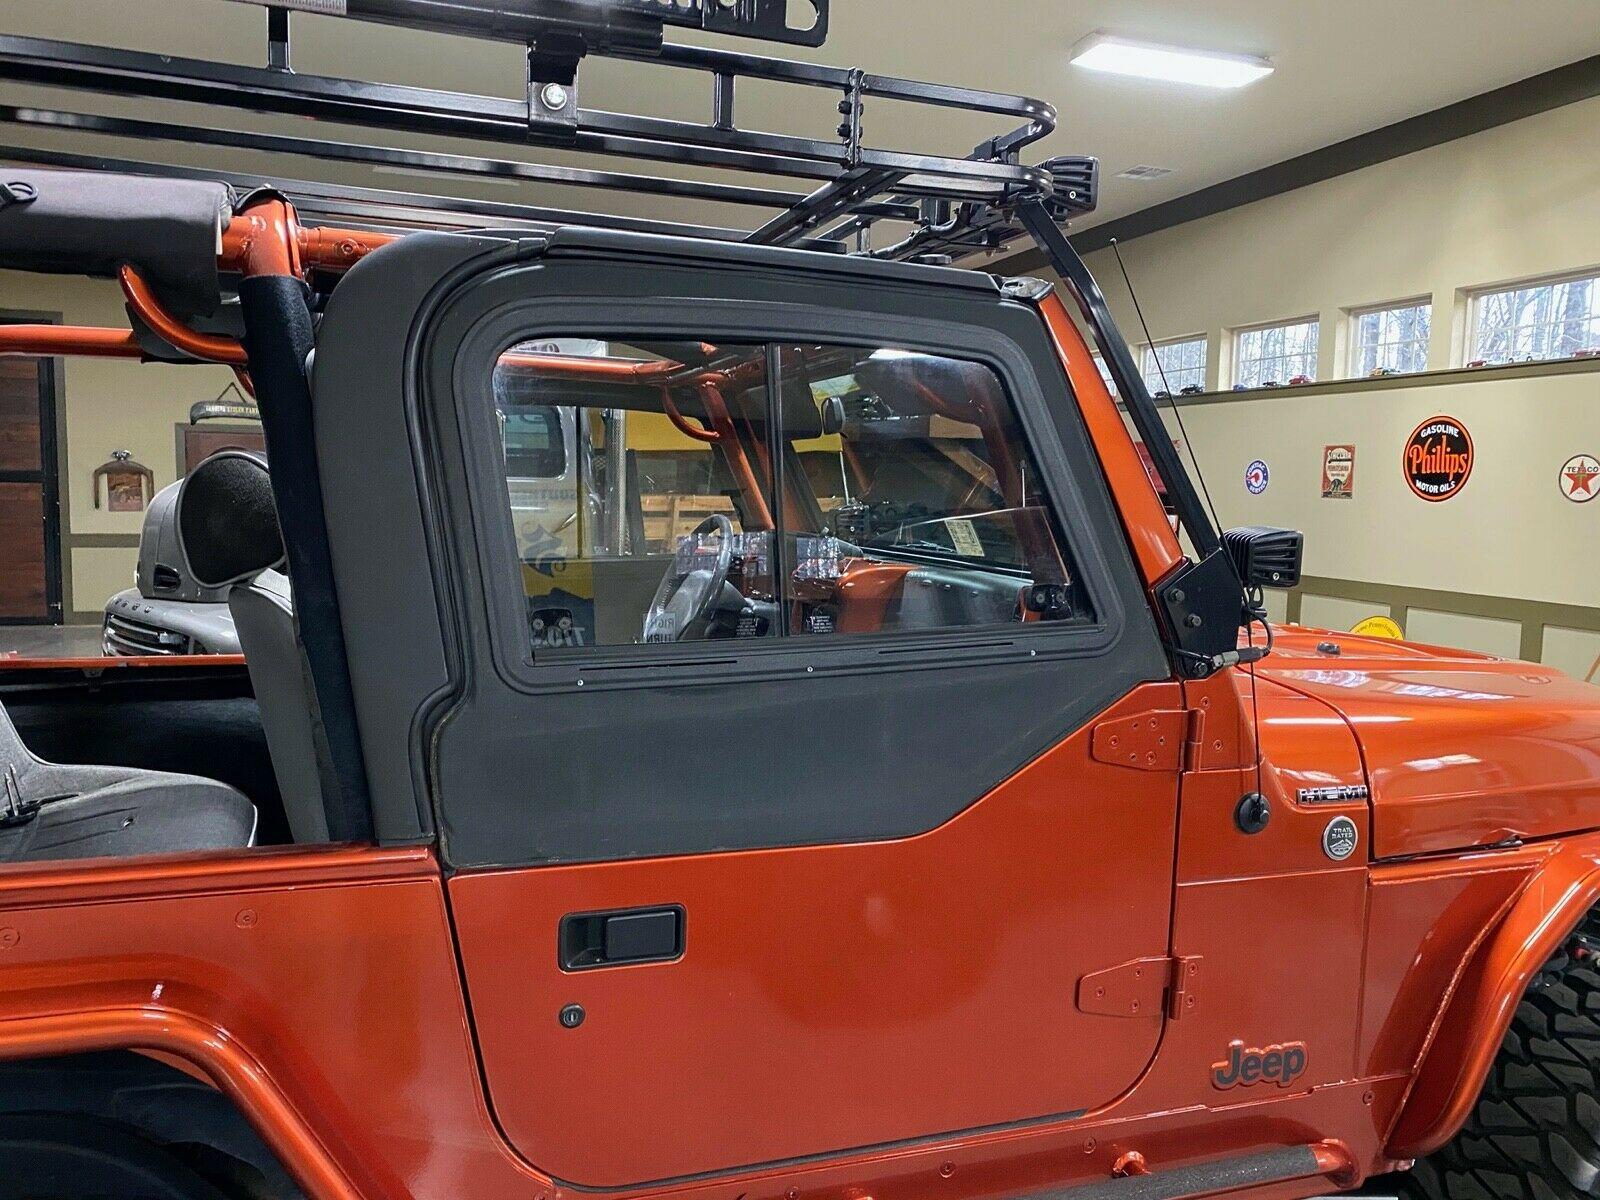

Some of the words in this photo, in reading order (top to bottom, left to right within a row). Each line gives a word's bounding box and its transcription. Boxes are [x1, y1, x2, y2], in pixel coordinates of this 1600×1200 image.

[1420, 424, 1459, 438] GASOLINE
[1409, 435, 1468, 481] Phillips
[1415, 479, 1439, 493] MOTOR
[1439, 480, 1456, 493] OILS
[1215, 1044, 1306, 1085] Jeep
